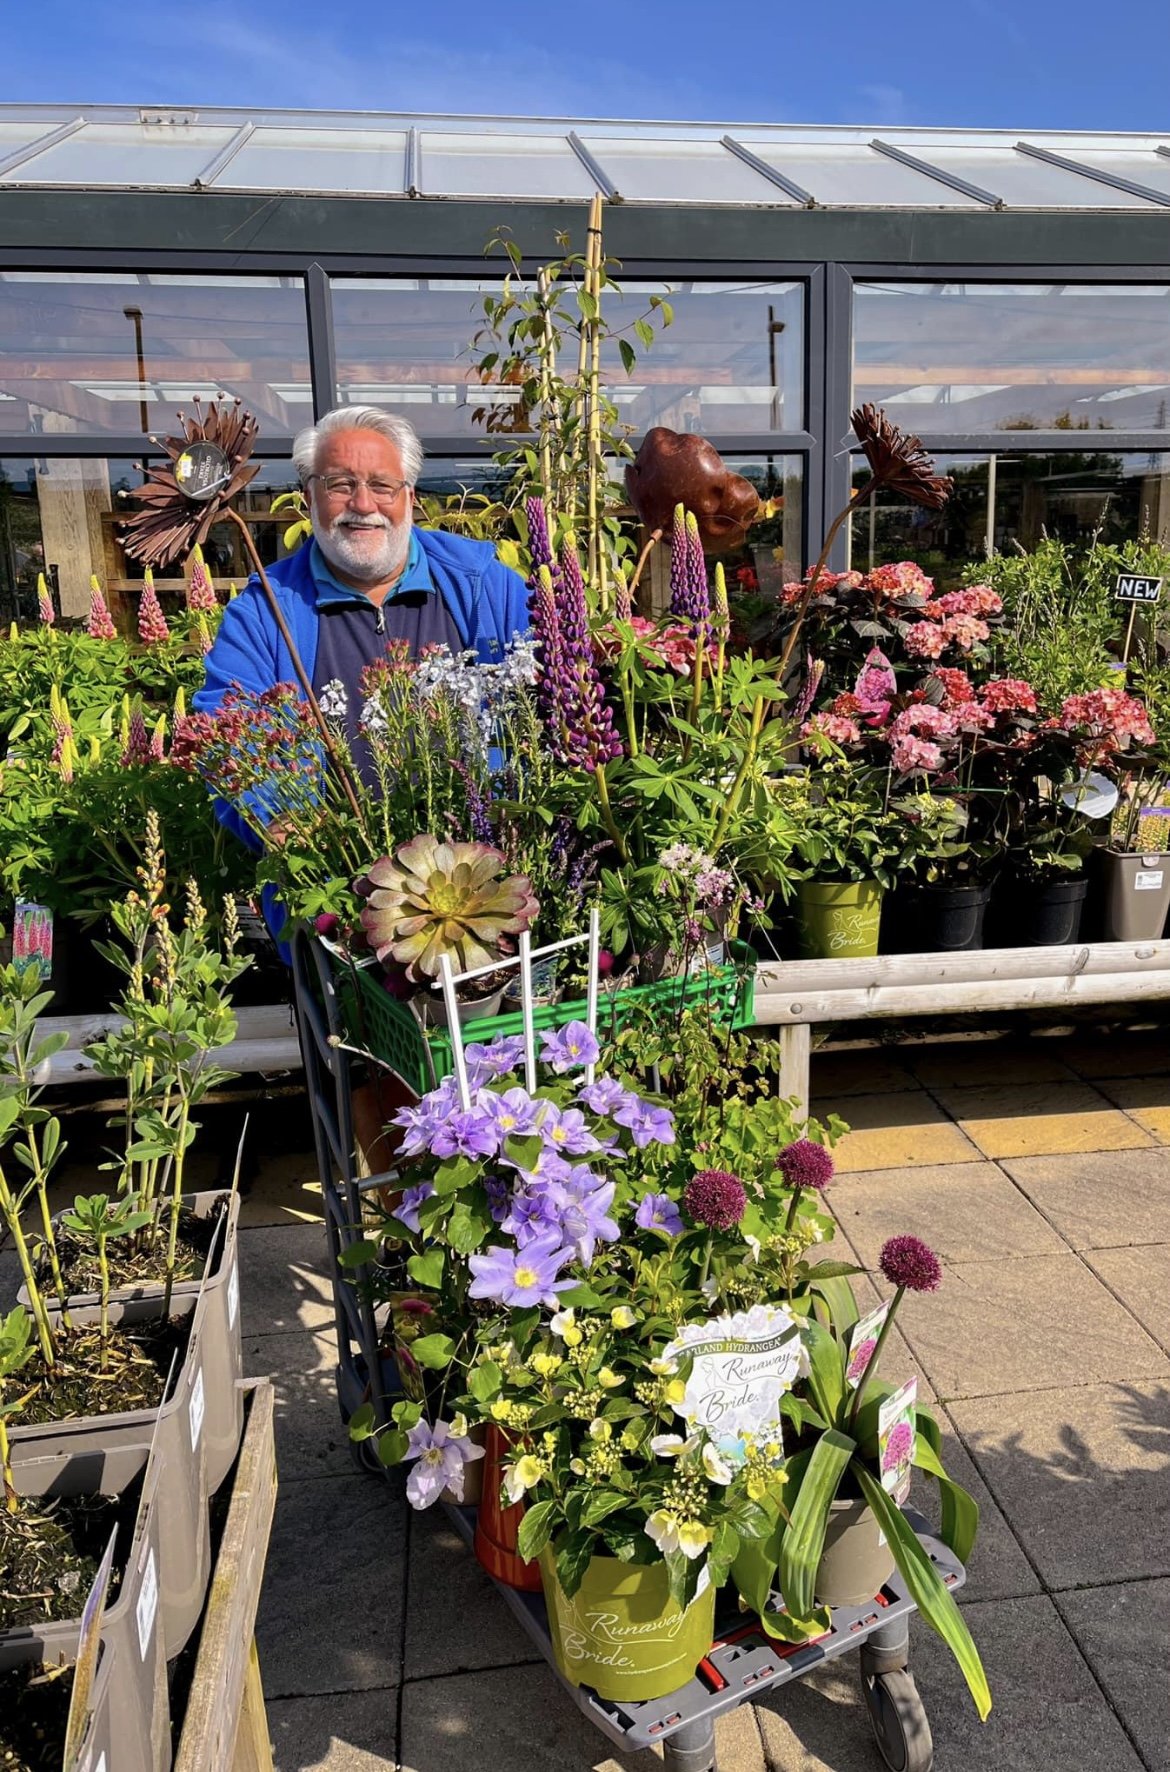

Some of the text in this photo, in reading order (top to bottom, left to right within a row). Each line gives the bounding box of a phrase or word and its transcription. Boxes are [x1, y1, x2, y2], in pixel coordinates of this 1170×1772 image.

[1120, 579, 1161, 599] NEW
[722, 1352, 792, 1381] Runaway
[585, 1610, 685, 1642] Runaway
